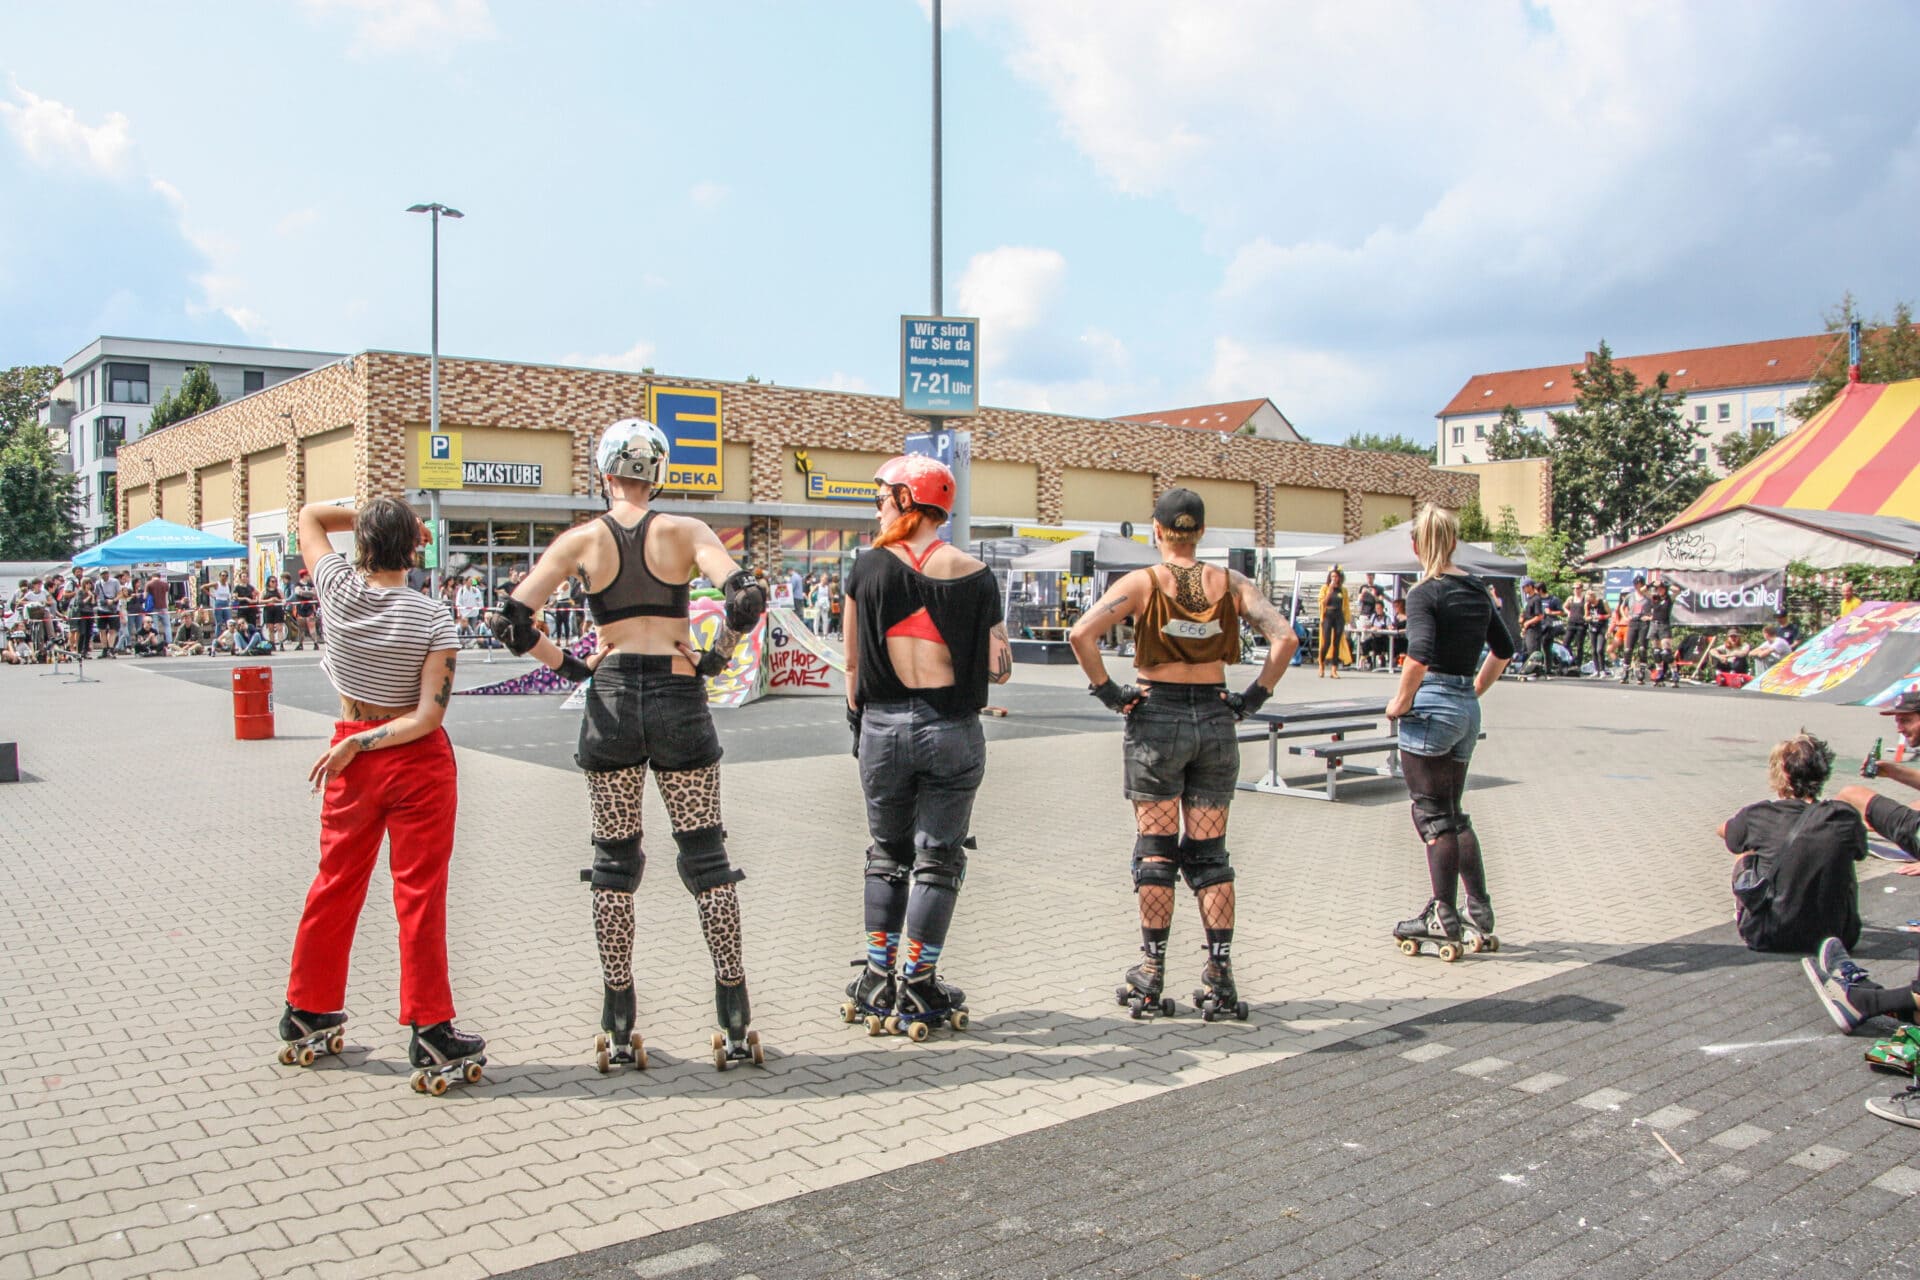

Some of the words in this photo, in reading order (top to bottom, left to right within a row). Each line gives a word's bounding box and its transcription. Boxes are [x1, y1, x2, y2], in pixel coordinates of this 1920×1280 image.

[914, 322, 937, 336] Wir
[940, 324, 967, 337] sind
[910, 336, 928, 349] für
[931, 337, 951, 350] Sie
[955, 338, 971, 351] da
[952, 382, 972, 395] Uhr
[433, 436, 448, 457] P
[937, 434, 950, 457] P
[665, 471, 718, 486] DEKA
[811, 475, 823, 491] E
[1179, 622, 1207, 636] 666
[771, 627, 789, 647] 8
[791, 649, 817, 669] HOP
[1212, 942, 1231, 956] 12
